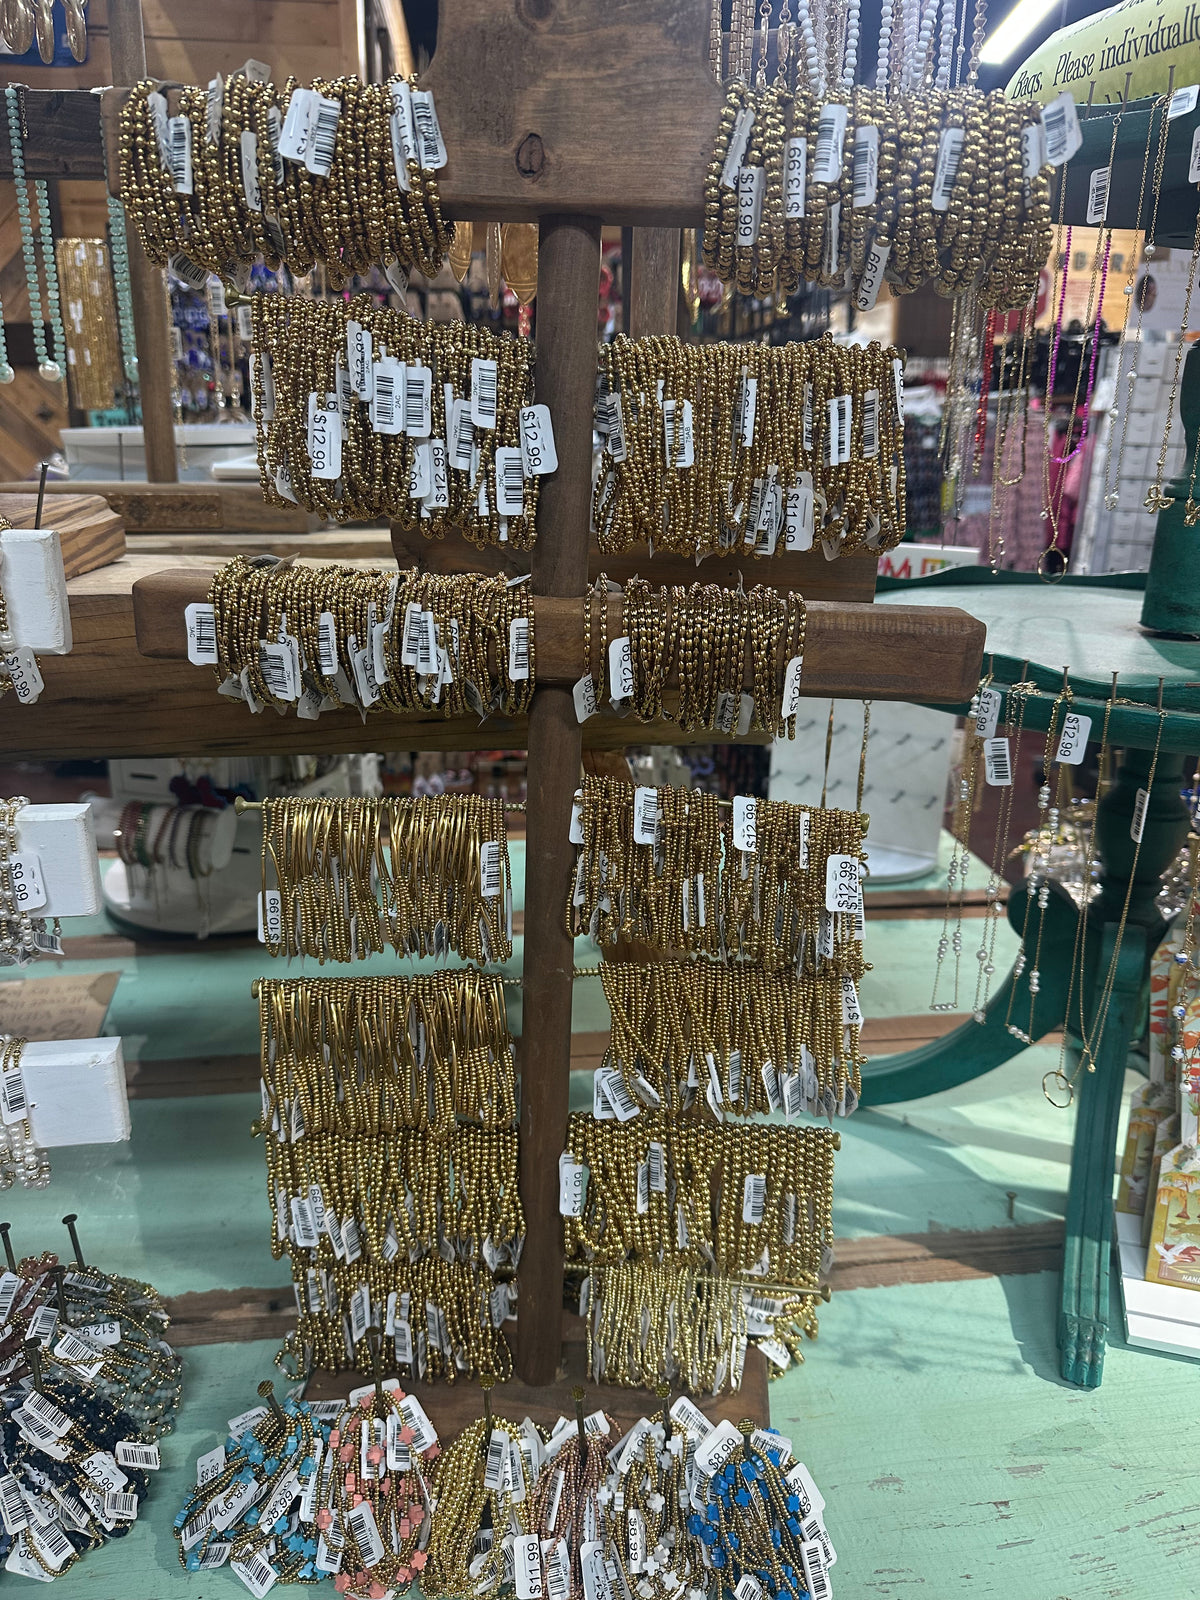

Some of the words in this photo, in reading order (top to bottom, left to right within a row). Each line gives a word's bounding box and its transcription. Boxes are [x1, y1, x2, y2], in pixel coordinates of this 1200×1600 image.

[1052, 51, 1096, 87] Please
[786, 147, 802, 213] $13.99
[739, 173, 755, 237] $13.99
[858, 252, 881, 306] $13.99
[312, 414, 327, 470] $12.99
[522, 411, 542, 468] $12.99
[433, 446, 447, 503] $12.99
[786, 493, 800, 543] $11.99
[6, 657, 31, 698] $13.99
[622, 643, 633, 693] $12.99
[586, 676, 597, 714] $12.99
[976, 691, 993, 731] $12.99
[1059, 716, 1080, 757] $12.99
[746, 804, 756, 849] $12.99
[838, 861, 851, 908] $12.99
[847, 864, 858, 910] $12.99
[269, 897, 280, 941] $10.99
[842, 976, 860, 1020] $12.99
[310, 1188, 326, 1229] $10.99
[572, 1171, 583, 1214] $11.99
[82, 1460, 115, 1492] $12.99
[200, 1462, 220, 1483] $8.99
[708, 1437, 737, 1471] $8.99
[219, 1483, 249, 1517] $8.99
[266, 1490, 294, 1526] $8.99
[35, 1537, 45, 1550] 15AB
[628, 1518, 639, 1562] $8.99
[527, 1542, 542, 1599] $11.99
